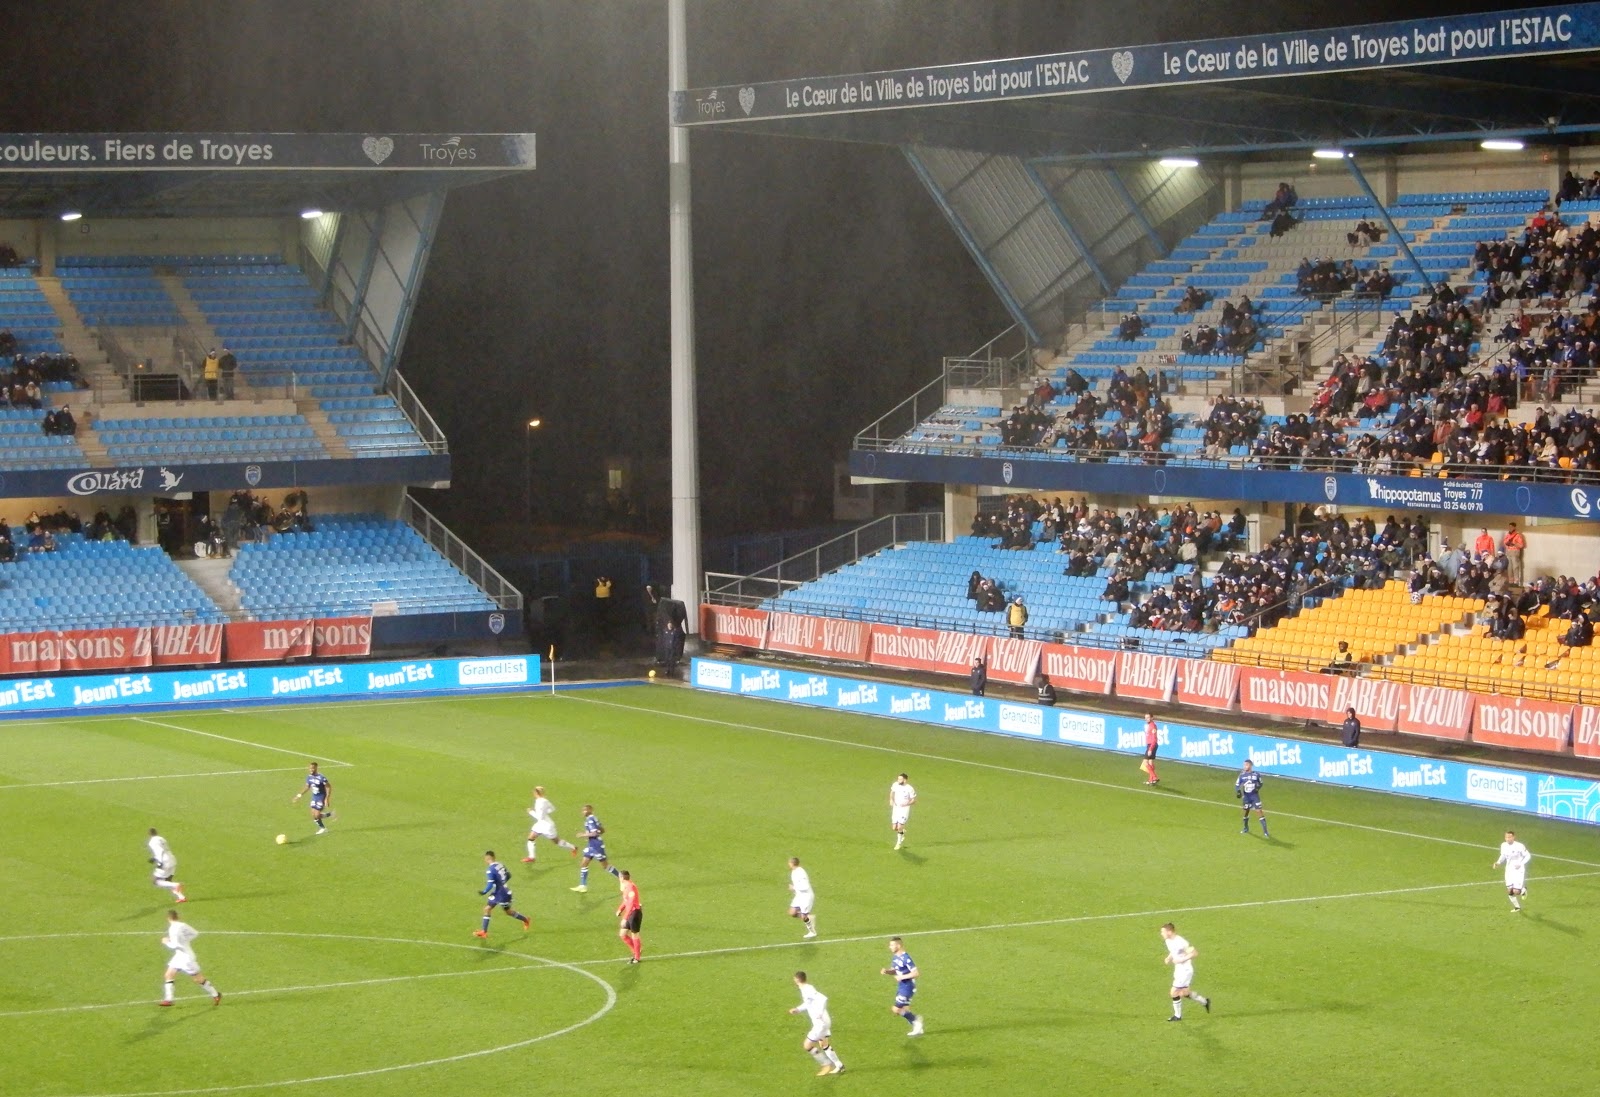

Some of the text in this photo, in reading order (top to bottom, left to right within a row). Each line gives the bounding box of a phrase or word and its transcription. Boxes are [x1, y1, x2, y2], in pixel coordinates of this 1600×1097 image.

[1164, 14, 1572, 75] Le Cœur de la Ville de Troyes bat pour l'ESTAC
[786, 59, 1090, 108] Le Cœur de la Ville de Troyes bat pour l'ESTAC
[696, 98, 726, 117] Troyes
[105, 139, 155, 161] Fiers
[163, 138, 193, 160] de
[200, 138, 273, 165] Troyes
[419, 143, 476, 165] Troyes
[67, 467, 144, 496] Collard
[1378, 485, 1442, 504] hippopotamus
[1443, 488, 1483, 501] Troyes 7/7
[1443, 501, 1483, 511] 03 25 46 09 70
[11, 624, 222, 663] maisons BABEAU
[263, 618, 370, 651] maisons
[873, 627, 935, 661] maisons
[173, 671, 247, 700] Jeun'Est
[271, 668, 343, 694] Jeun'Est
[367, 663, 434, 690] Jeun'Est
[740, 669, 780, 693] Jeun'Est
[788, 677, 829, 699] Jeun'Est
[73, 675, 152, 705] Jeun'Est
[837, 684, 878, 707] Jeun'Est
[1249, 671, 1329, 710] maisons
[890, 692, 931, 714] Jeun'Est
[944, 700, 985, 722] Jeun'Est
[1180, 732, 1235, 758] Jeun'Est
[1248, 743, 1302, 768] Jeun'Est
[1317, 753, 1373, 778] Jeun'Est
[1391, 763, 1447, 788] Jeun'Est
